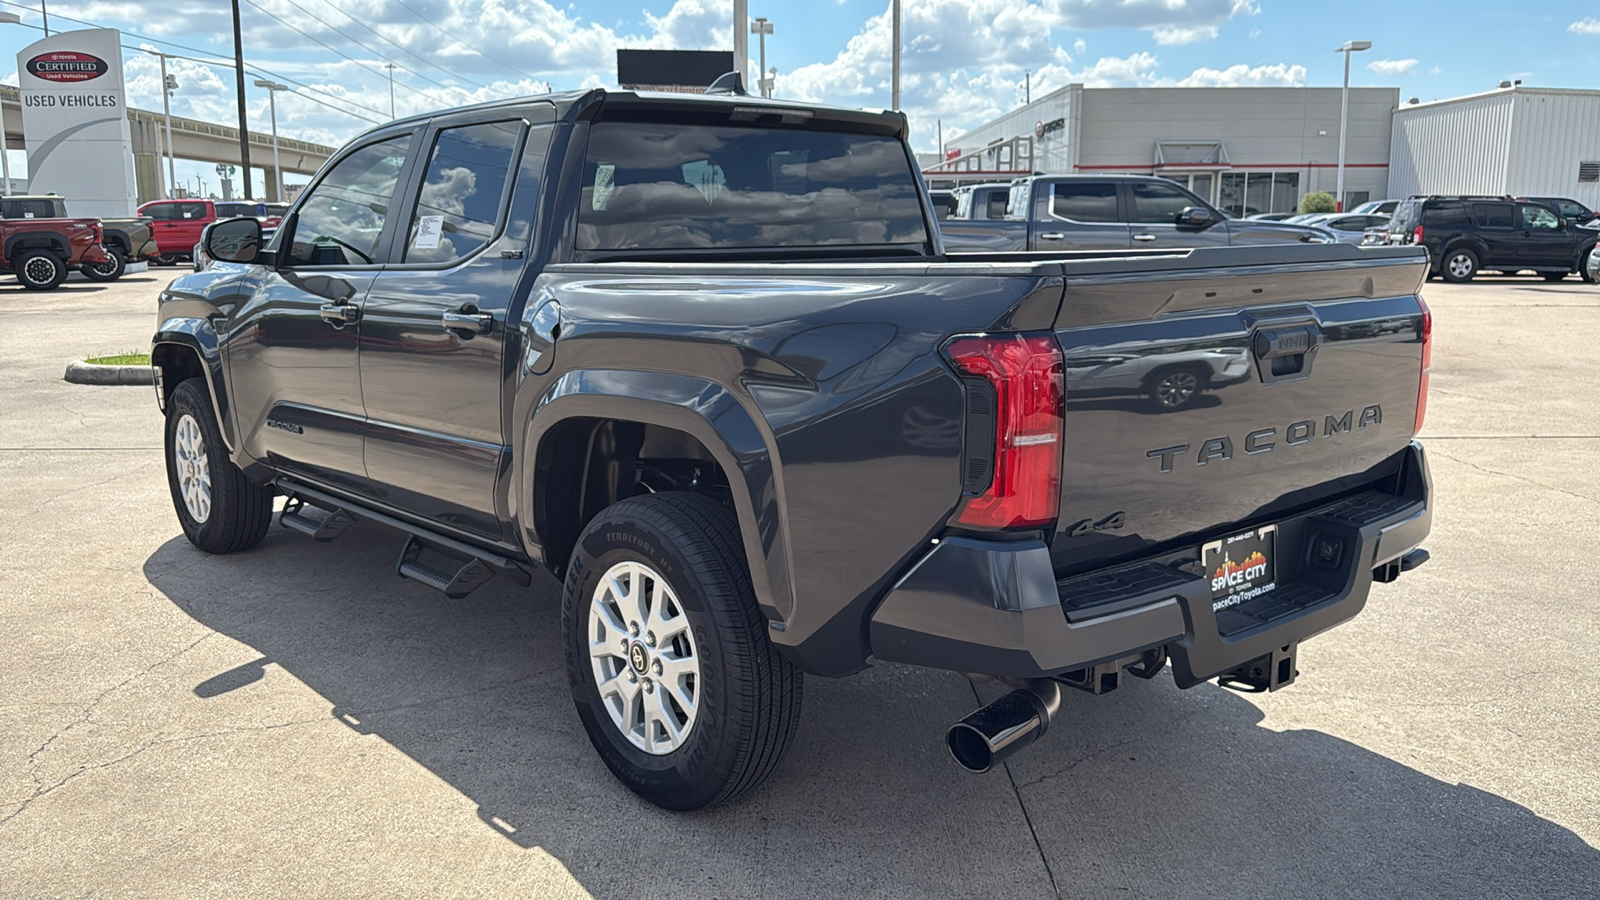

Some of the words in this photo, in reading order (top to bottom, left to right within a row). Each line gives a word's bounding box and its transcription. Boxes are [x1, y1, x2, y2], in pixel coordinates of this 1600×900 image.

[25, 95, 56, 107] USED
[59, 95, 117, 107] VEHICLES
[266, 419, 304, 434] TACOMA
[1146, 403, 1383, 474] TACOMA
[606, 531, 656, 556] TERRITORY
[1211, 566, 1244, 591] SPACE
[1245, 562, 1267, 580] CITY
[1235, 582, 1252, 591] TOYOTA
[1212, 583, 1275, 613] paceCityToyota.com
